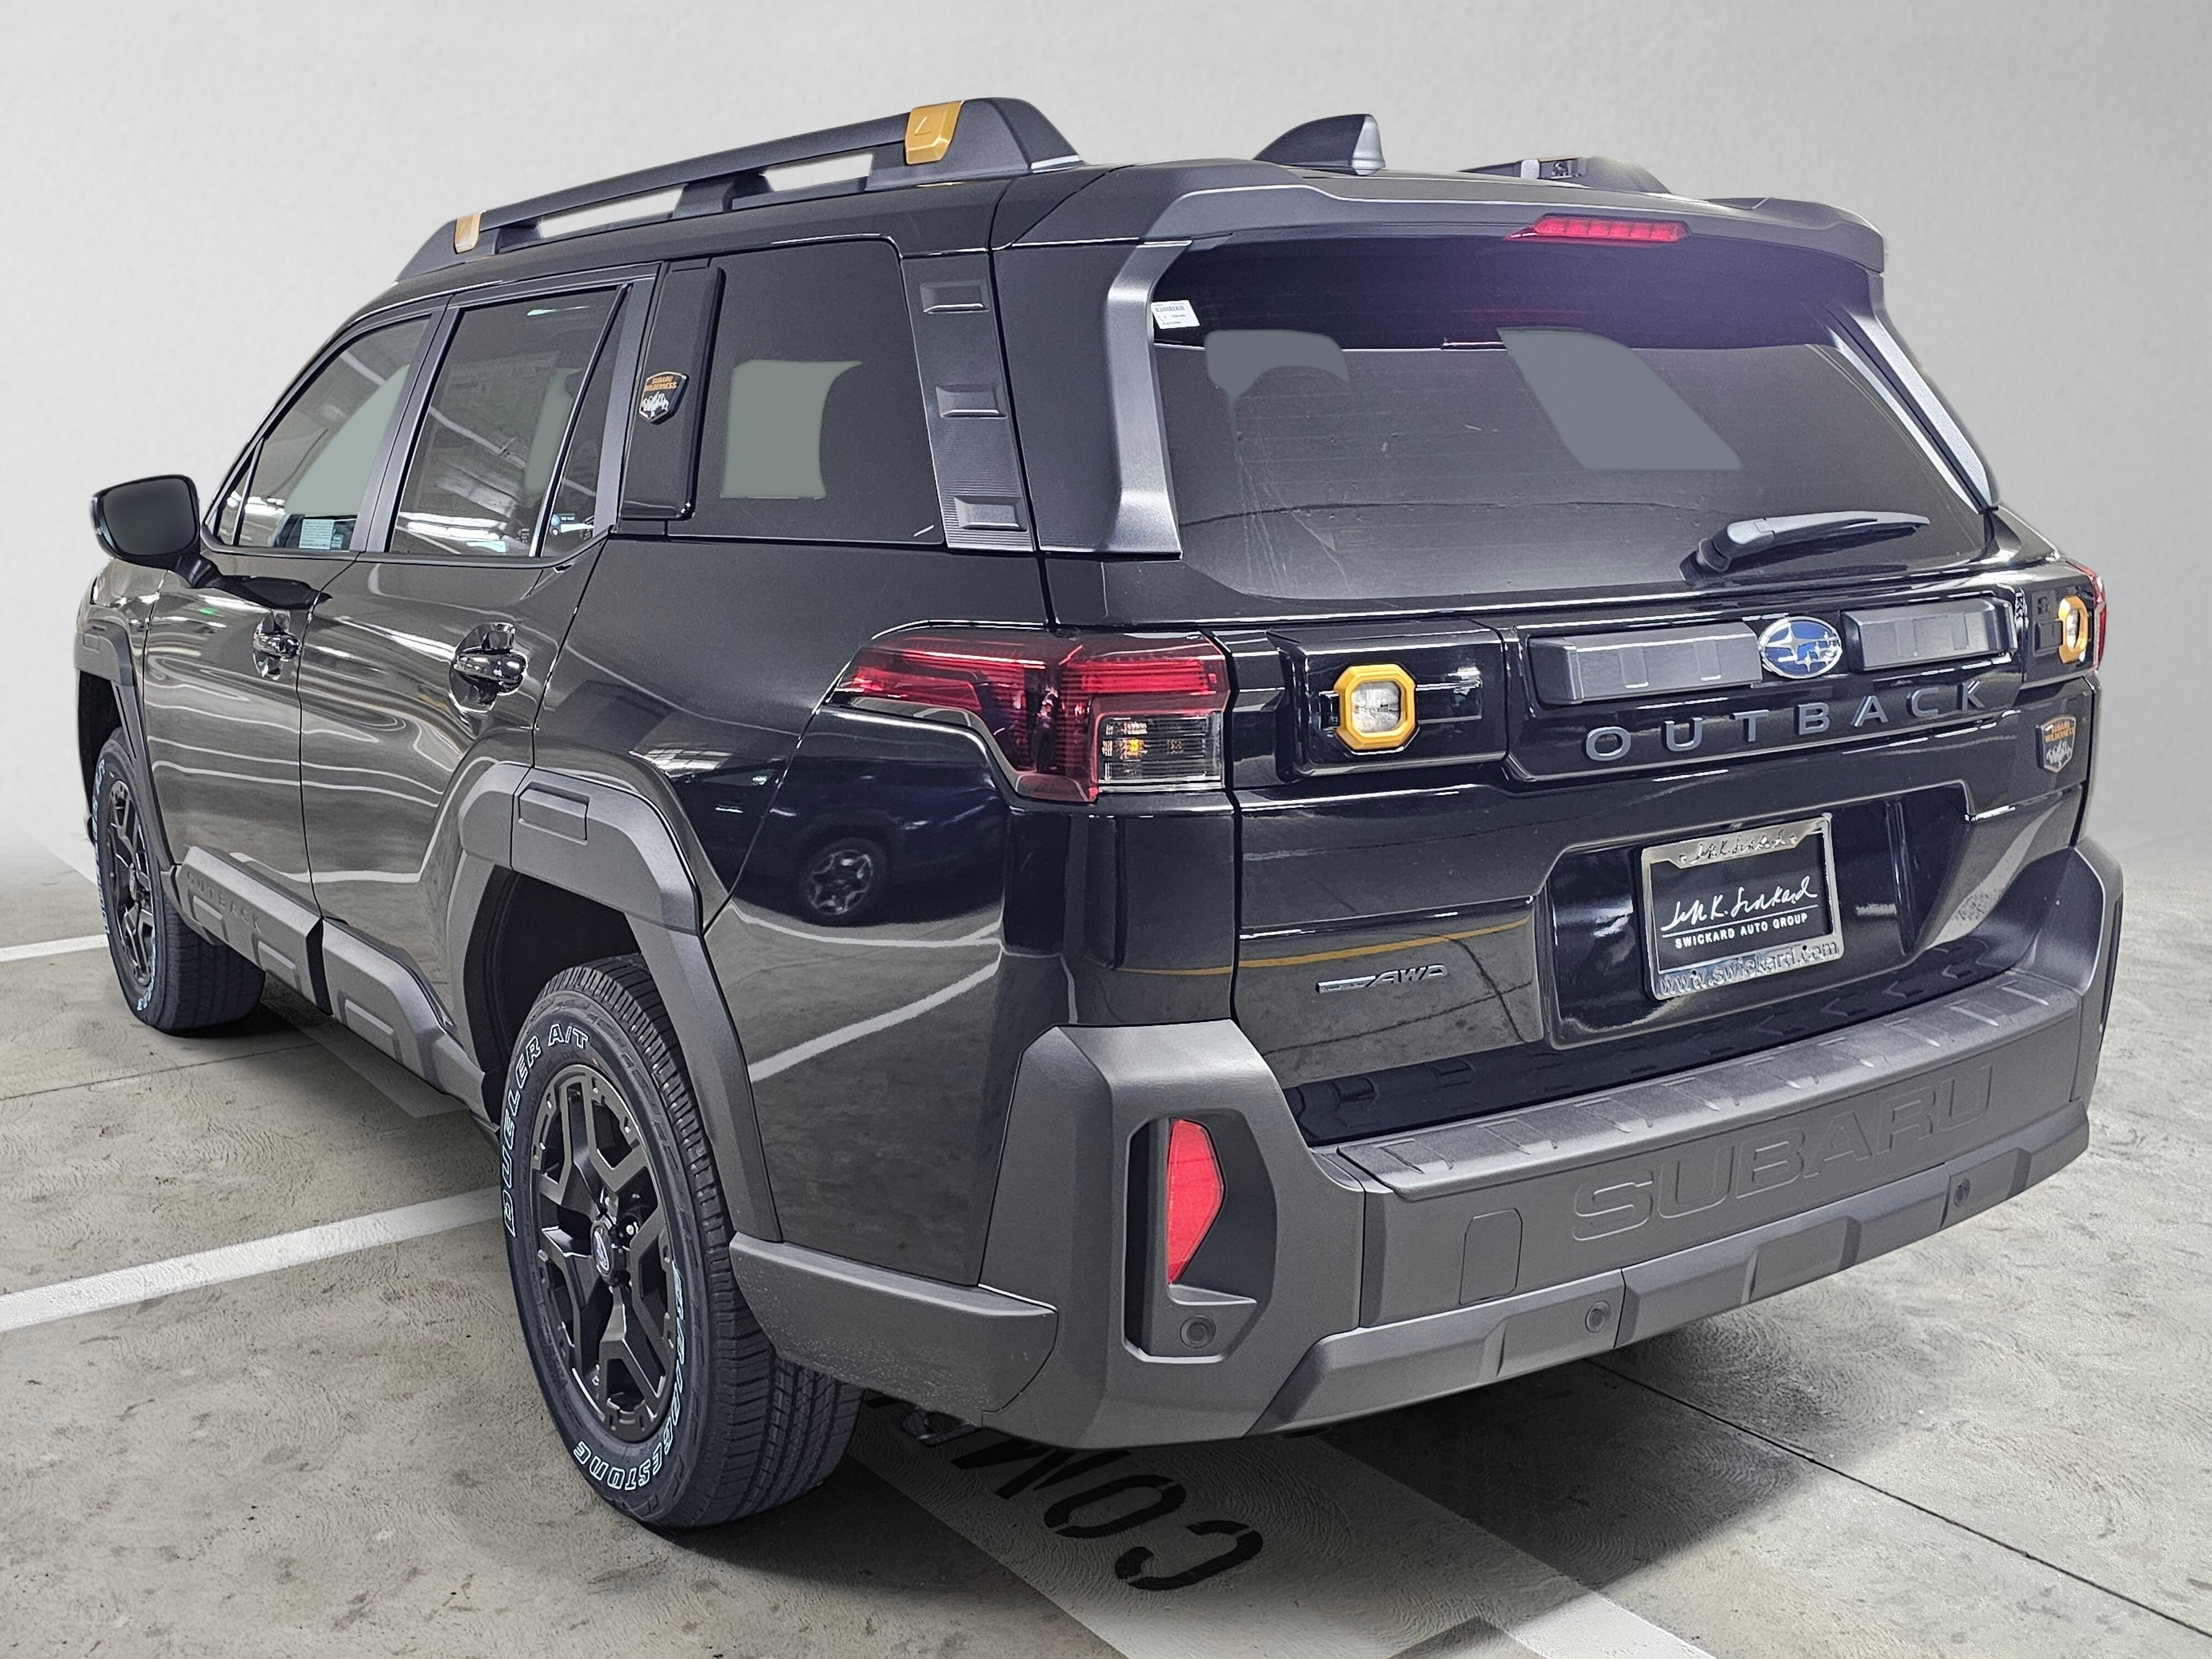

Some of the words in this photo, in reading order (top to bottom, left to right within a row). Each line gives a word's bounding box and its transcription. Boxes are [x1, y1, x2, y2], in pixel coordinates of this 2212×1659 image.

[1584, 680, 1986, 761] OUTBACK
[187, 871, 262, 934] OUTBACK
[1675, 927, 1735, 949] SWICKARD
[1740, 920, 1768, 936] AUTO
[1772, 912, 1808, 929] GROUP
[1365, 963, 1448, 988] AWD
[1660, 941, 1839, 995] www.swickard.com
[501, 1035, 541, 1238] DUELER
[1571, 1065, 1992, 1242] SUBARU
[865, 1396, 1264, 1591] COM
